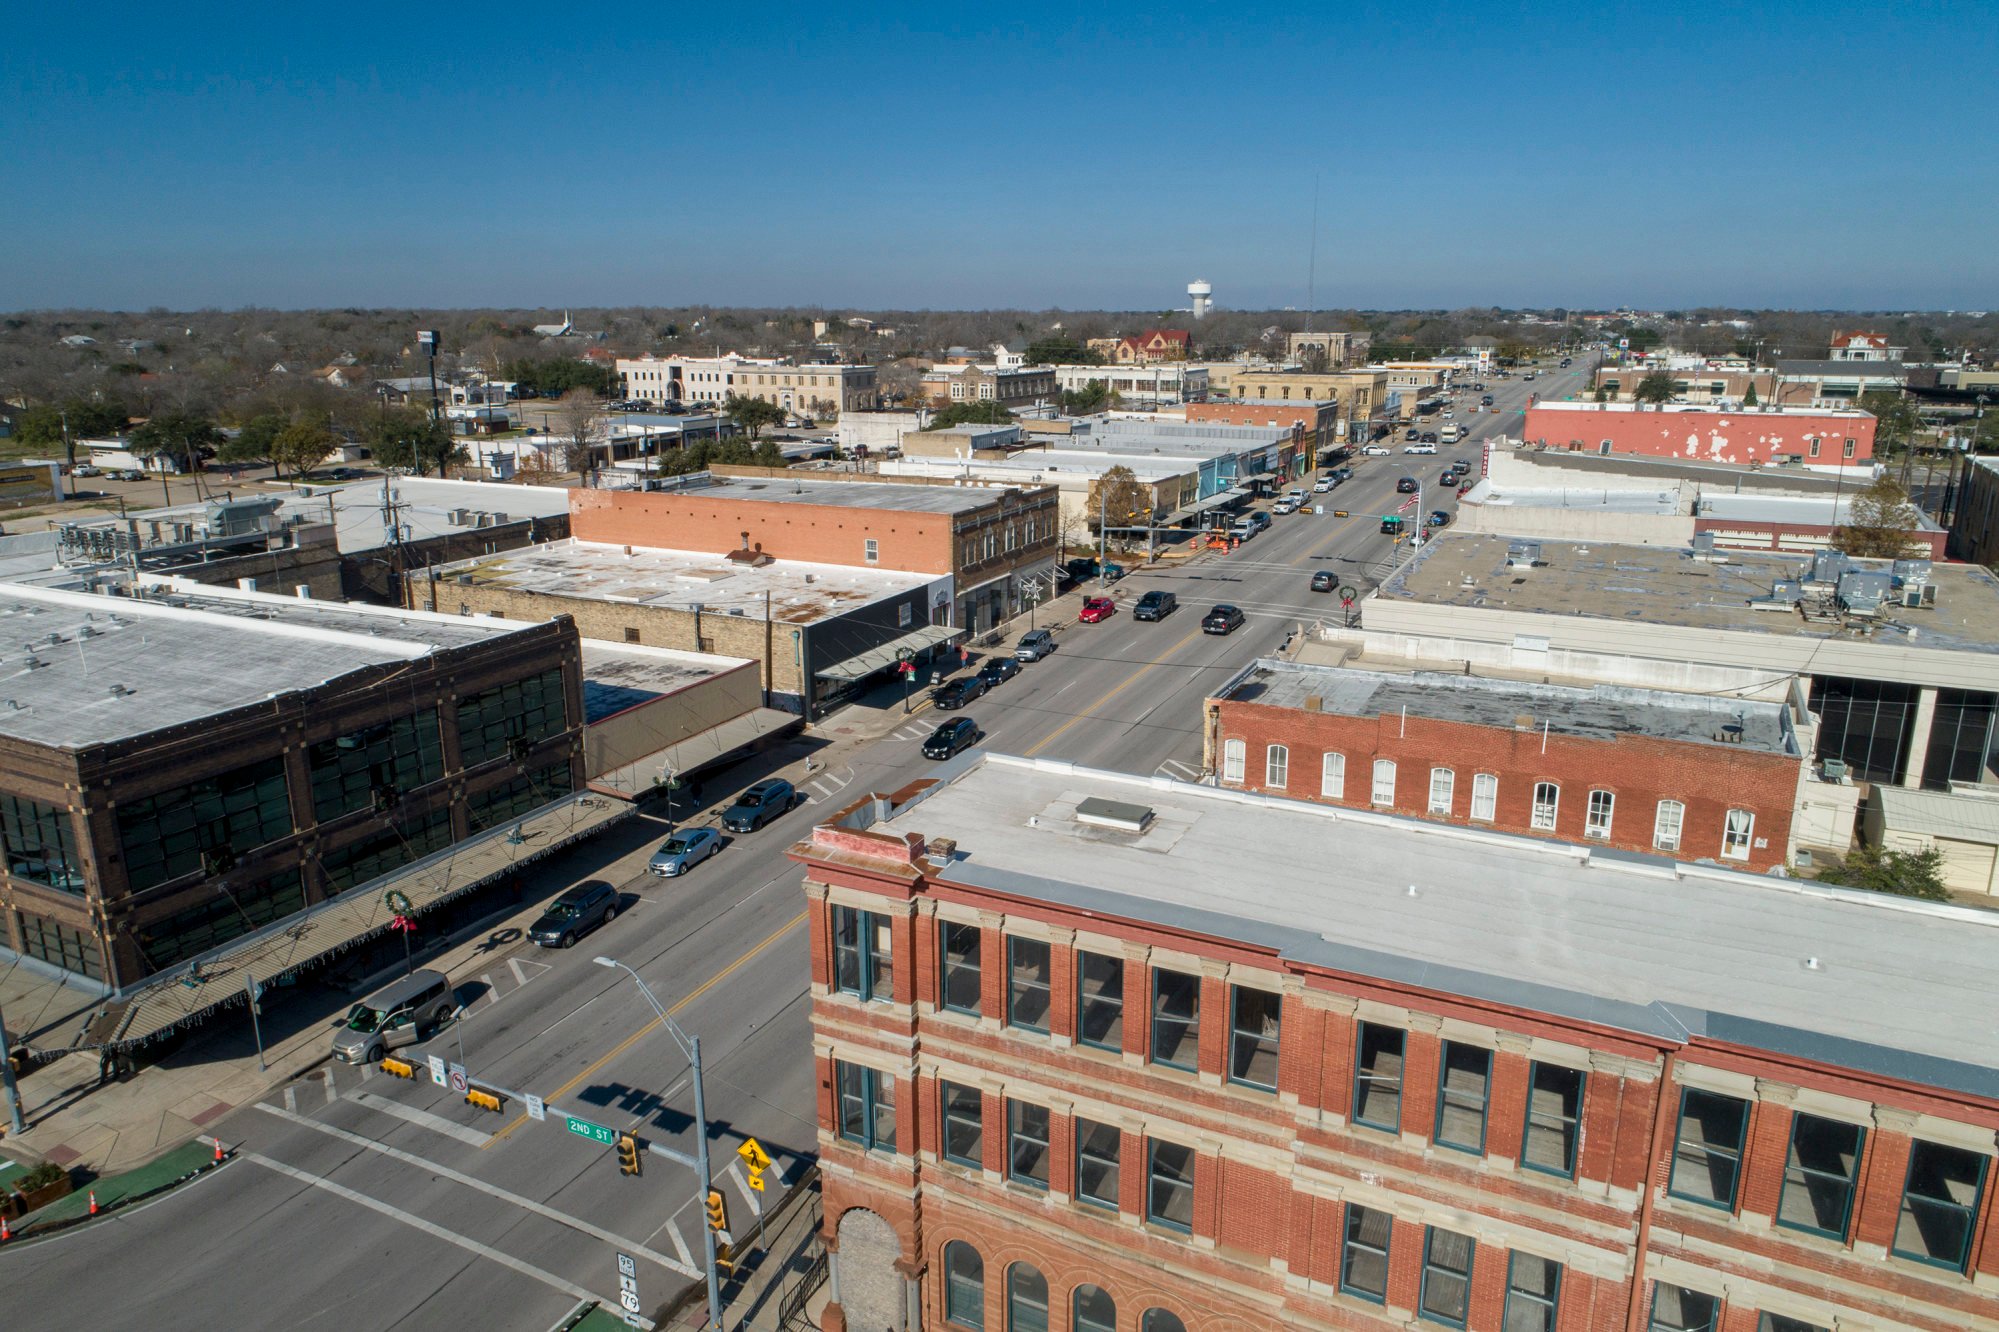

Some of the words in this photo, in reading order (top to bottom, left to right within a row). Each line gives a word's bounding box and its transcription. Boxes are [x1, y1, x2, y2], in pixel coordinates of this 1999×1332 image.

[569, 1119, 590, 1135] 2ND
[595, 1129, 608, 1141] ST
[620, 1256, 633, 1269] 95
[622, 1292, 637, 1309] 79
